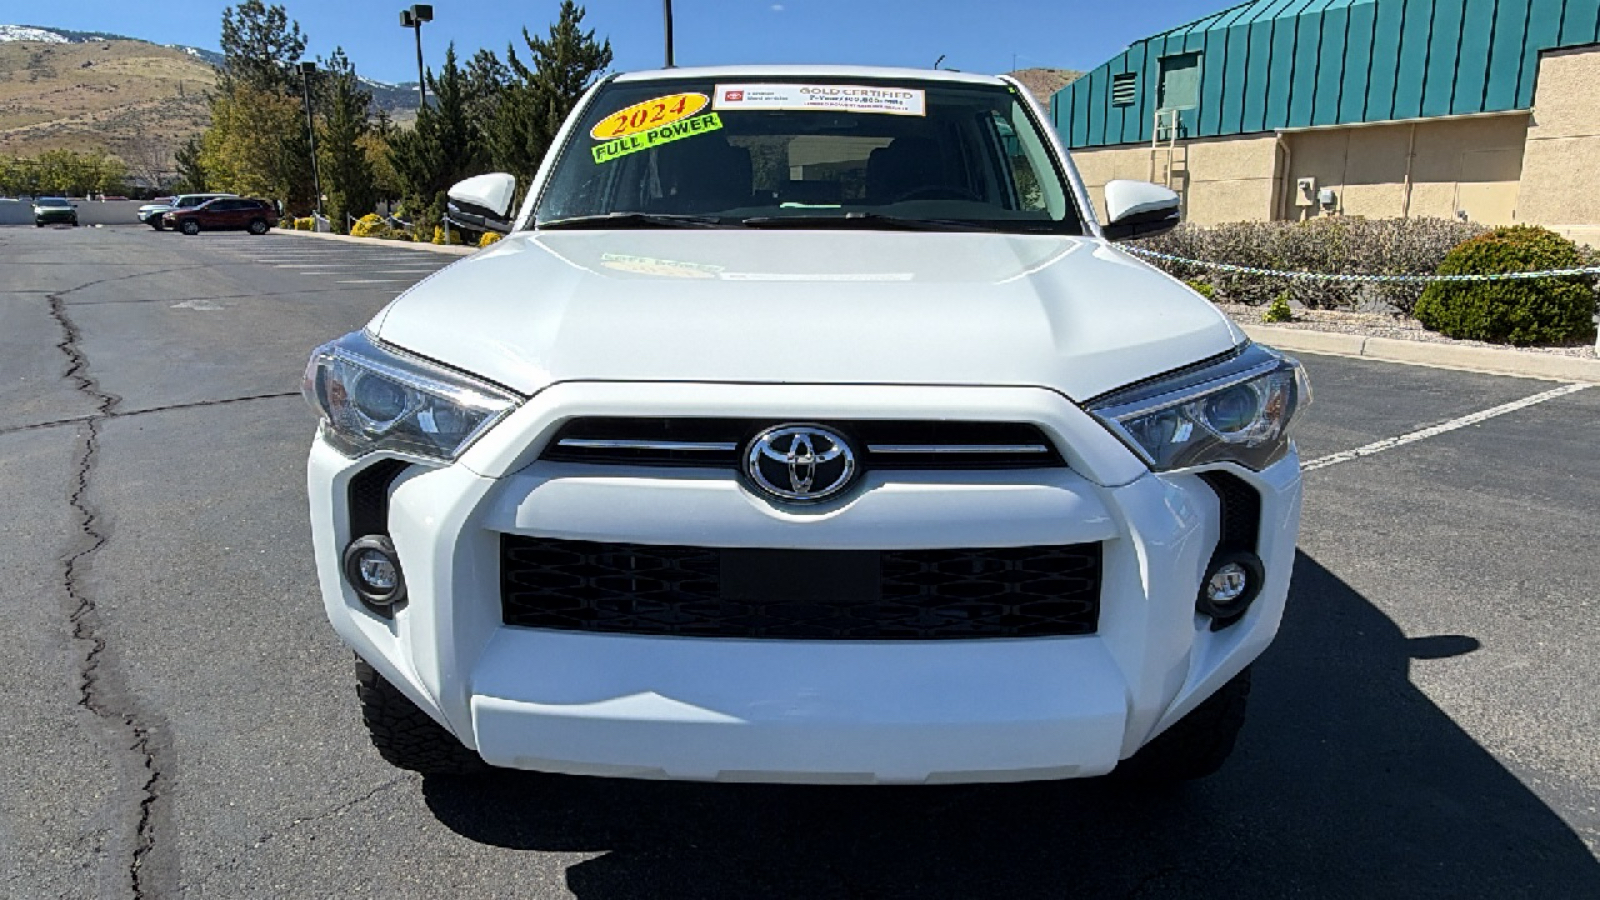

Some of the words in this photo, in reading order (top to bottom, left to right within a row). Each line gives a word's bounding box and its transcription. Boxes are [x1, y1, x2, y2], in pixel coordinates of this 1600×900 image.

[799, 87, 841, 96] GOLD
[612, 96, 687, 135] 2024
[595, 138, 641, 160] FULL
[648, 116, 715, 143] POWER
